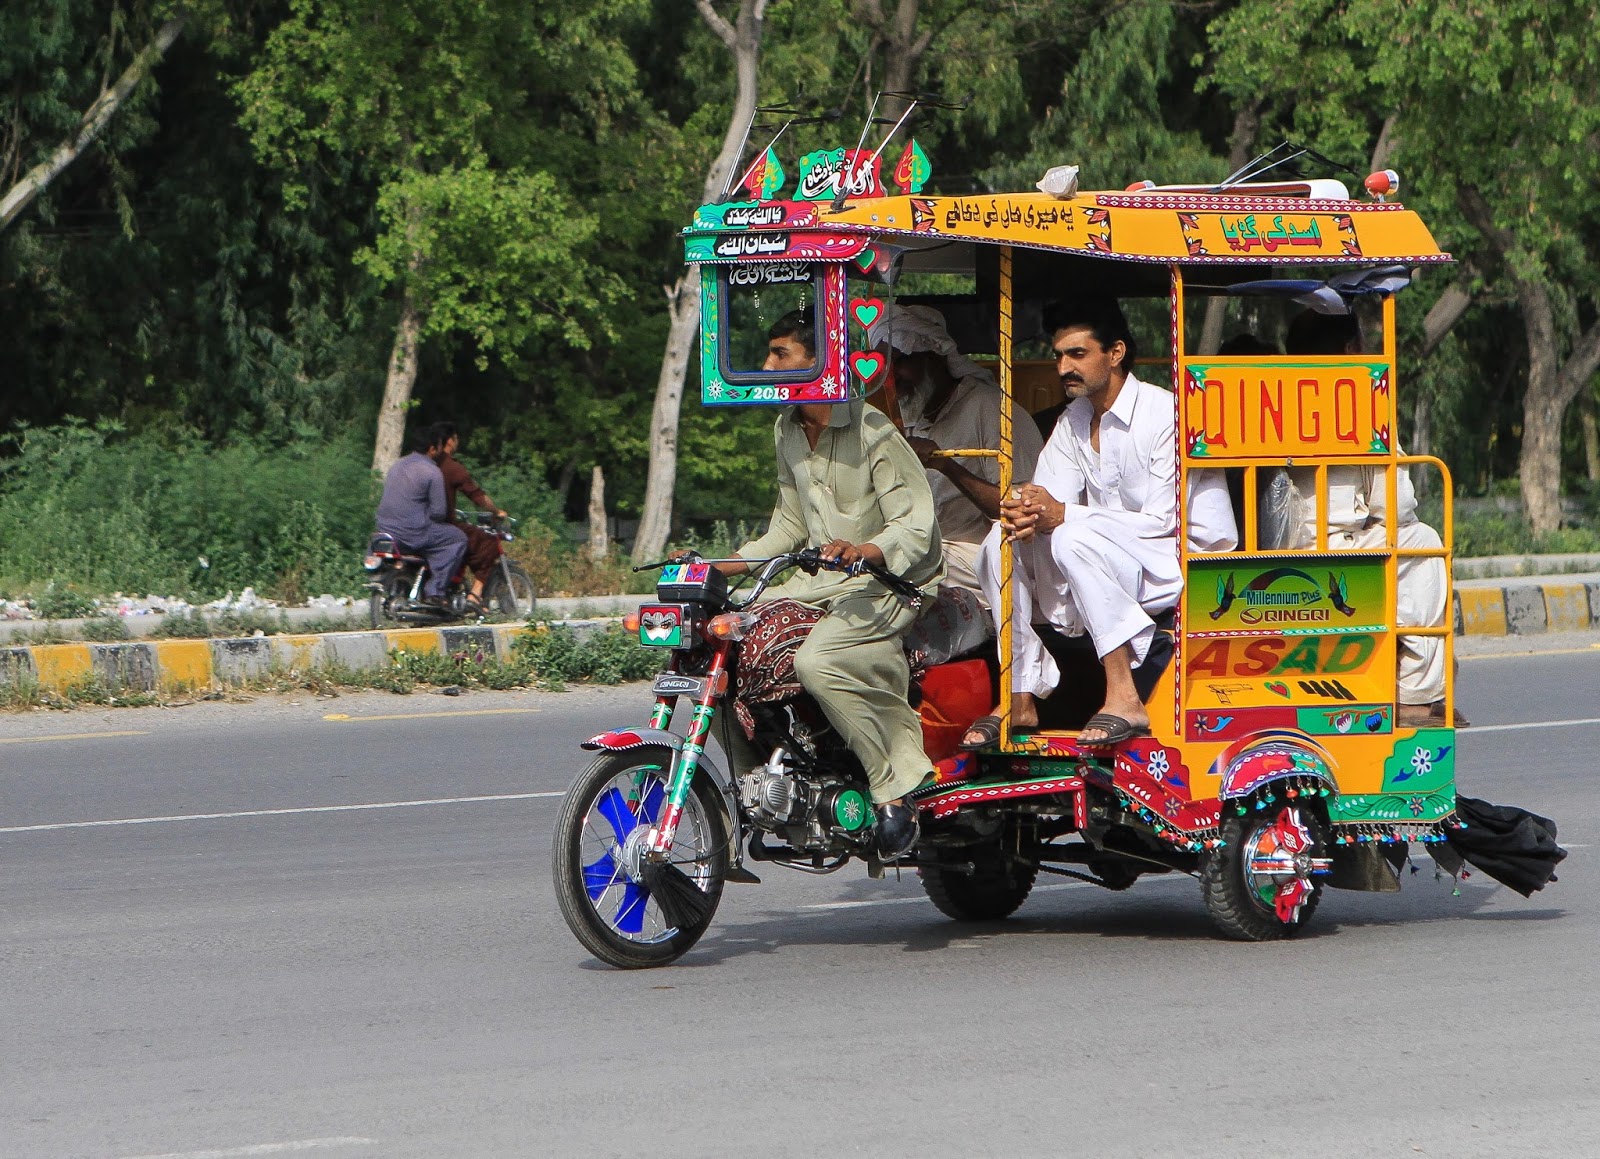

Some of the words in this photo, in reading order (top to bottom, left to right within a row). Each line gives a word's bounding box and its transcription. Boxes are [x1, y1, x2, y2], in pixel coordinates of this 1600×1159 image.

[983, 199, 999, 228] کی
[1001, 199, 1022, 229] ماں
[1023, 204, 1059, 231] میری
[1260, 215, 1290, 253] کی
[1288, 216, 1323, 249] اسد
[753, 387, 790, 401] 2013
[1246, 590, 1300, 606] Millennium
[1301, 589, 1322, 605] Plus
[1264, 609, 1330, 622] QINGQI
[1187, 635, 1376, 676] ASAD
